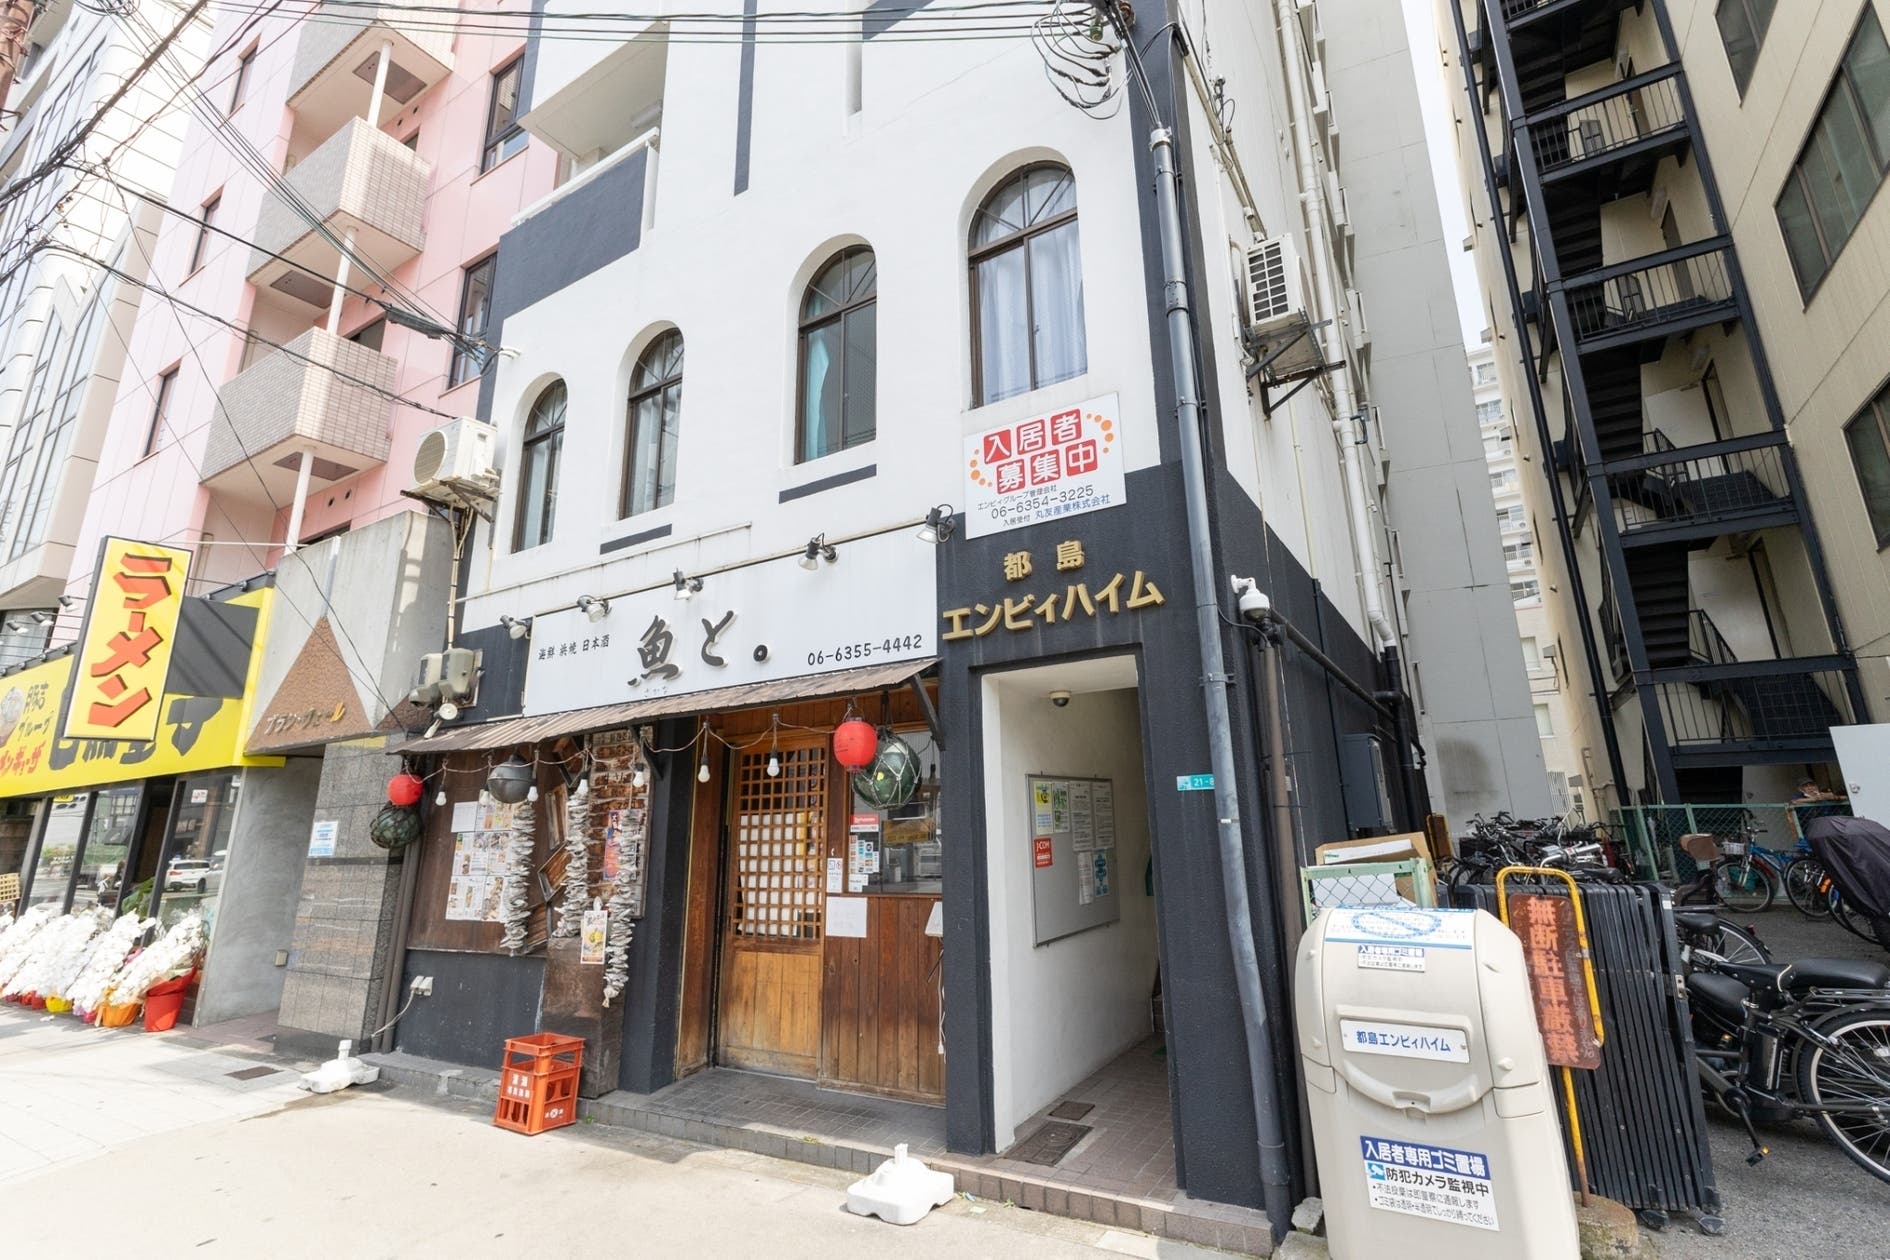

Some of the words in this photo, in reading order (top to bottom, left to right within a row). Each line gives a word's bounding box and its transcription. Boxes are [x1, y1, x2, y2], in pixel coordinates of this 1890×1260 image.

[984, 411, 1080, 463] 入居者
[998, 442, 1097, 493] 募集中
[991, 485, 1094, 520] 06-6354-3225
[1003, 540, 1085, 582] 都島
[942, 570, 1166, 641] エンビィハイム
[87, 553, 174, 729] ラーメン
[582, 634, 610, 652] 日本酒
[807, 634, 923, 667] 06-6355-4442
[1356, 1031, 1451, 1052] 都島エンビィハイム
[1364, 1140, 1486, 1177] 入居者専用ゴミ置場
[1386, 1167, 1489, 1197] 防犯カメラ監視中
